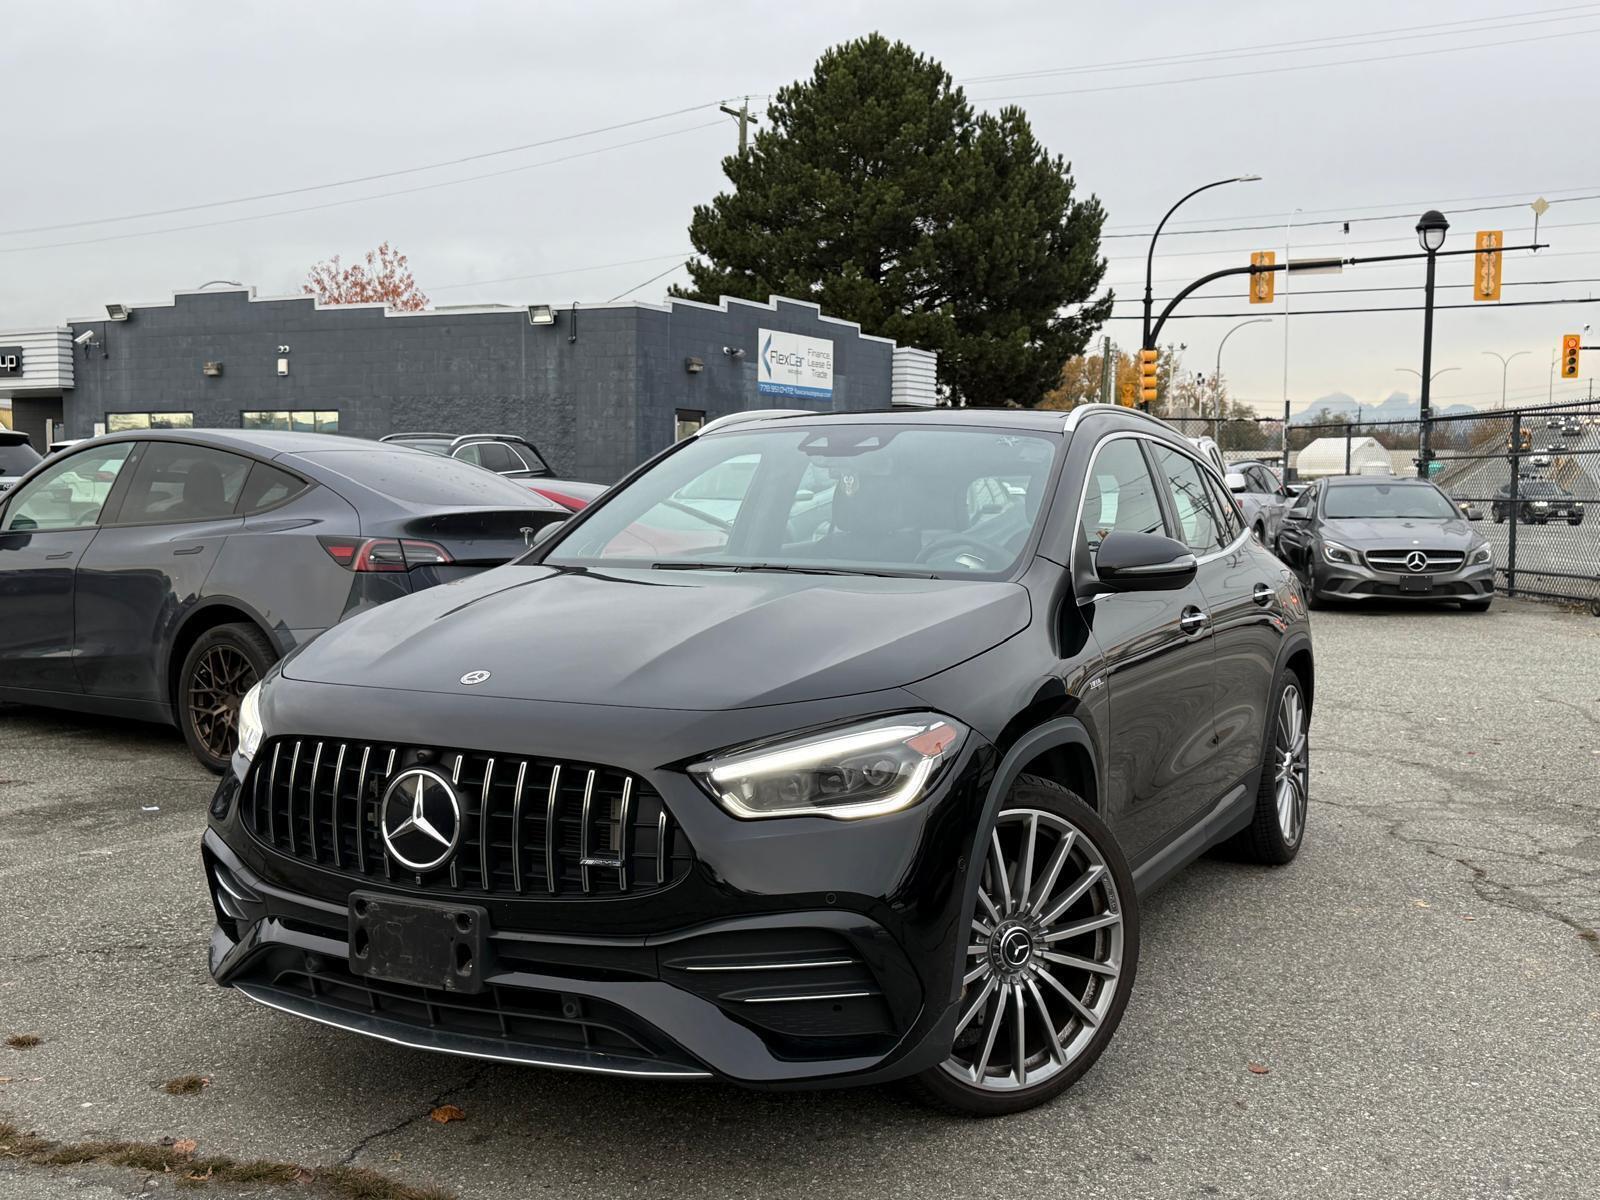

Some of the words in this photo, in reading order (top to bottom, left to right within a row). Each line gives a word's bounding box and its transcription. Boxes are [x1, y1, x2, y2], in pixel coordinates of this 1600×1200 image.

[770, 350, 805, 368] FlexCar
[807, 359, 825, 369] Lease
[811, 368, 828, 379] Trade
